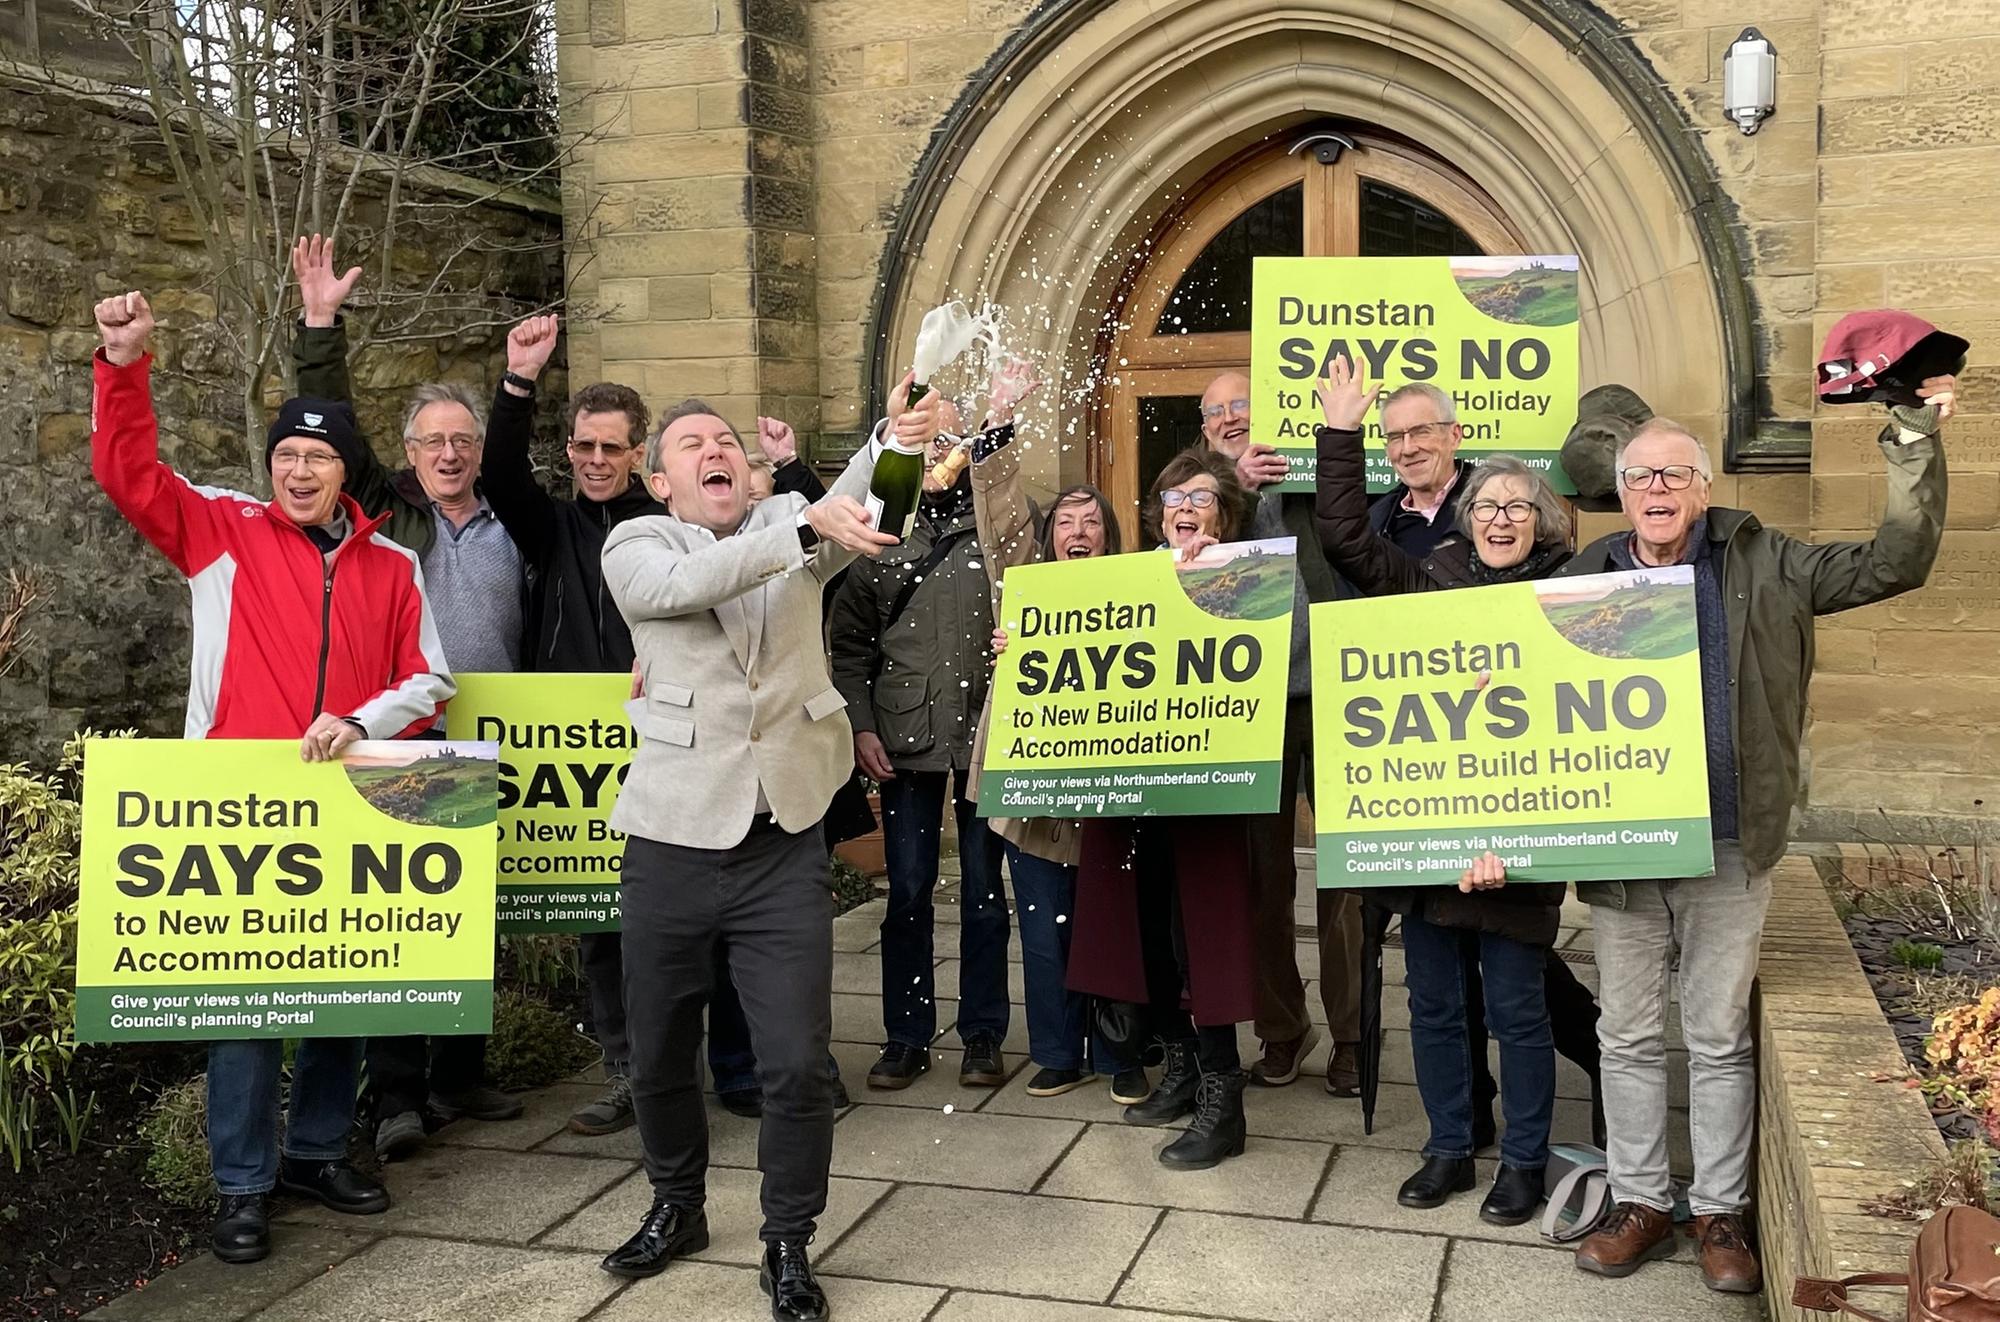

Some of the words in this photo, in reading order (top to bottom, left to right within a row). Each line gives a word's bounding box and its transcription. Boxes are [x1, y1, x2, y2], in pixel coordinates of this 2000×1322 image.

[1278, 296, 1435, 327] Dunstan
[1278, 338, 1438, 381] SAYS
[1460, 338, 1551, 381] NO
[1277, 390, 1301, 410] to
[1453, 390, 1551, 416] Holiday
[1282, 455, 1304, 466] ive
[1020, 601, 1156, 638] Dunstan
[1016, 642, 1156, 696] SAYS
[1175, 634, 1263, 685] NO
[1340, 640, 1521, 683] Dunstan
[1013, 708, 1034, 728] to
[1041, 705, 1089, 727] New
[1097, 699, 1157, 724] Build
[1166, 695, 1260, 722] Holiday
[1343, 685, 1530, 749] SAYS
[1555, 675, 1667, 735] NO
[1009, 729, 1210, 759] Accommodation!
[1345, 760, 1372, 784] to
[1383, 757, 1446, 783] New
[1457, 750, 1538, 779] Build
[1549, 743, 1671, 775] Holiday
[498, 762, 632, 809] SAY
[1004, 777, 1028, 789] Give
[1032, 778, 1058, 791] your
[1060, 776, 1091, 788] views
[1094, 775, 1111, 787] via
[1113, 772, 1208, 787] Northumberland
[1212, 770, 1256, 785] County
[117, 791, 319, 828] Dunstan
[1002, 793, 1054, 806] Council's
[1056, 792, 1105, 808] planning
[1108, 791, 1142, 804] Portal
[1346, 783, 1612, 820] Accommodation!
[516, 820, 577, 842] New
[1346, 840, 1378, 854] Give
[1382, 840, 1414, 855] your
[1418, 837, 1461, 852] views
[1465, 836, 1488, 850] via
[1492, 832, 1616, 848] Northumberland
[1620, 828, 1679, 845] County
[116, 843, 323, 898] SAYS
[351, 841, 462, 895] NO
[1346, 858, 1413, 872] Council's
[1417, 855, 1473, 872] plannin
[1501, 854, 1532, 868] ortal
[512, 894, 544, 906] your
[548, 892, 587, 903] views
[591, 891, 611, 903] via
[114, 910, 146, 936] to
[159, 909, 230, 936] New
[242, 908, 328, 935] Build
[340, 907, 462, 938] Holiday
[497, 909, 541, 920] uncil's
[546, 908, 606, 923] planning
[113, 943, 400, 973] Accommodation!
[111, 994, 149, 1009] Give
[153, 995, 190, 1011] your
[194, 992, 240, 1008] views
[244, 992, 268, 1006] via
[272, 990, 401, 1006] Northumberland
[406, 989, 462, 1005] County
[110, 1013, 187, 1029] Council's
[191, 1012, 262, 1030] planning
[266, 1010, 314, 1026] Portal
